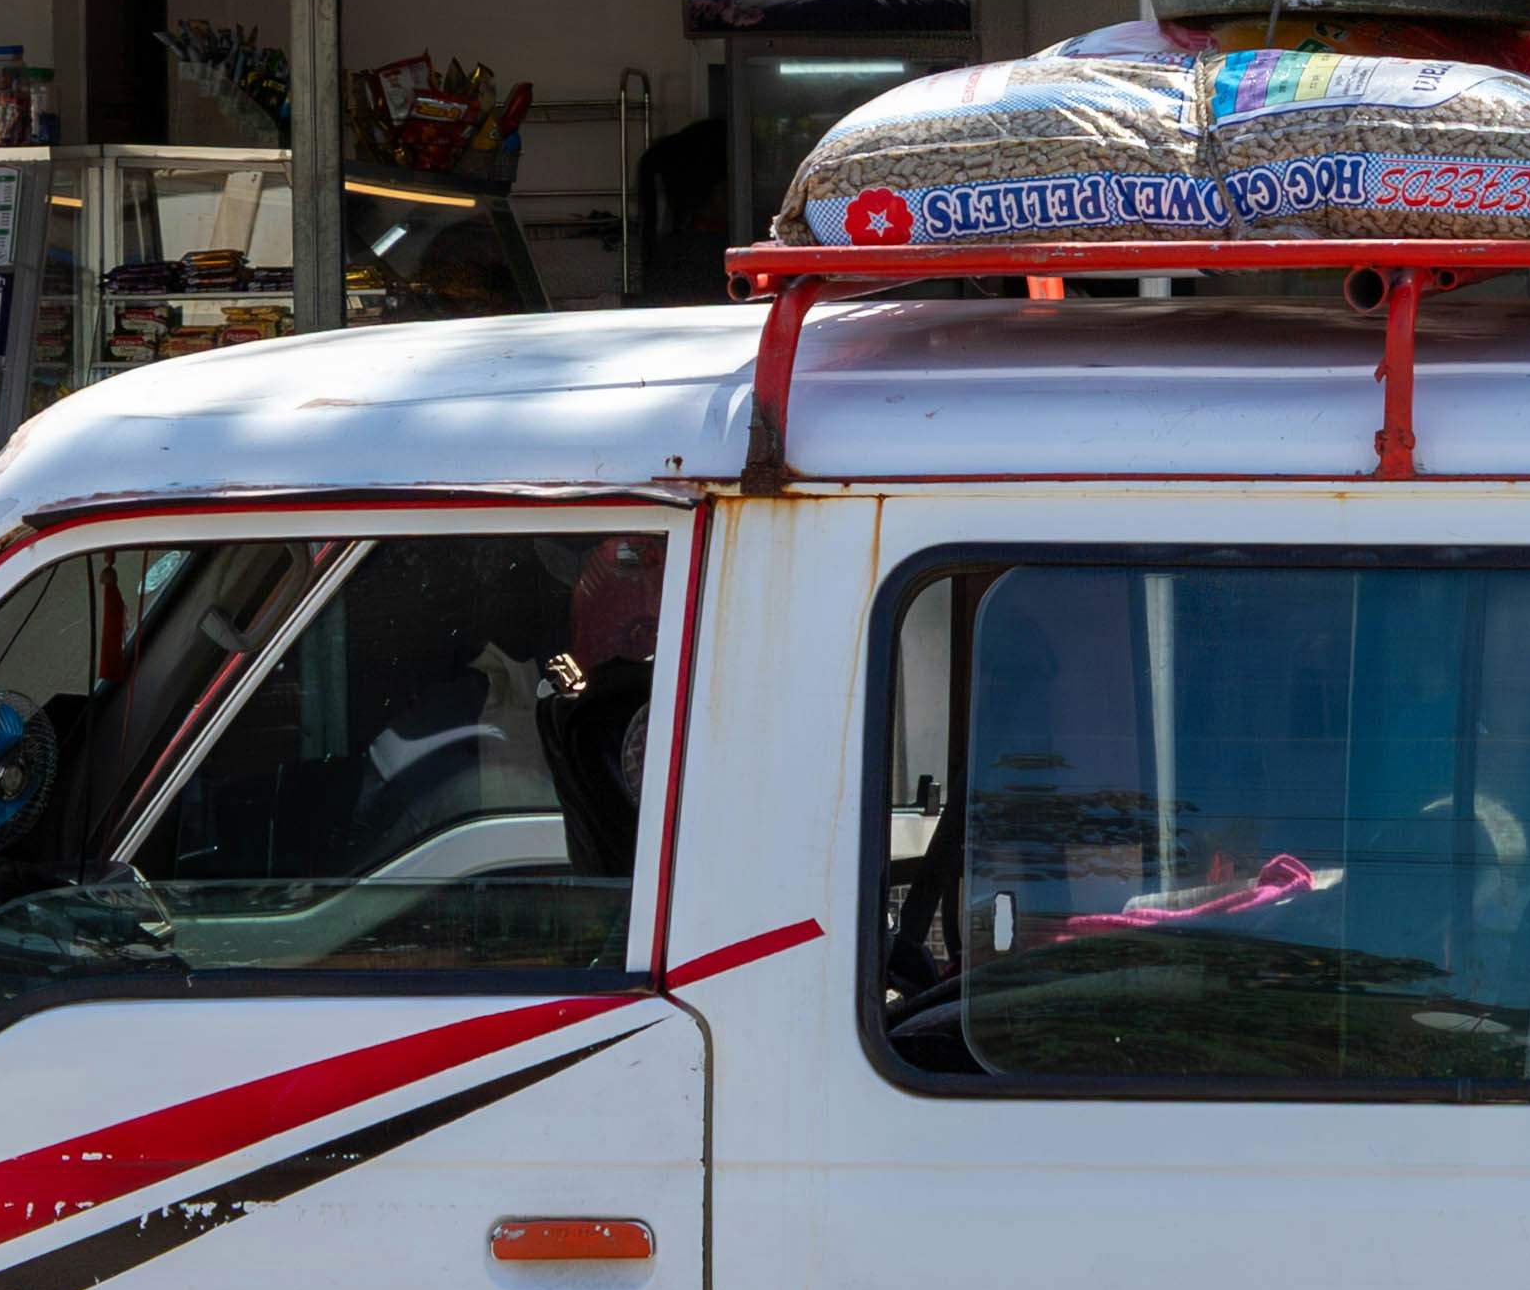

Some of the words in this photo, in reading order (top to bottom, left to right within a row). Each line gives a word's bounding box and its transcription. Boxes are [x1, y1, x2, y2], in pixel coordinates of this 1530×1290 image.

[920, 173, 1110, 240] PELLETS
[1111, 160, 1284, 229] GROWER
[1284, 154, 1367, 210] HOG
